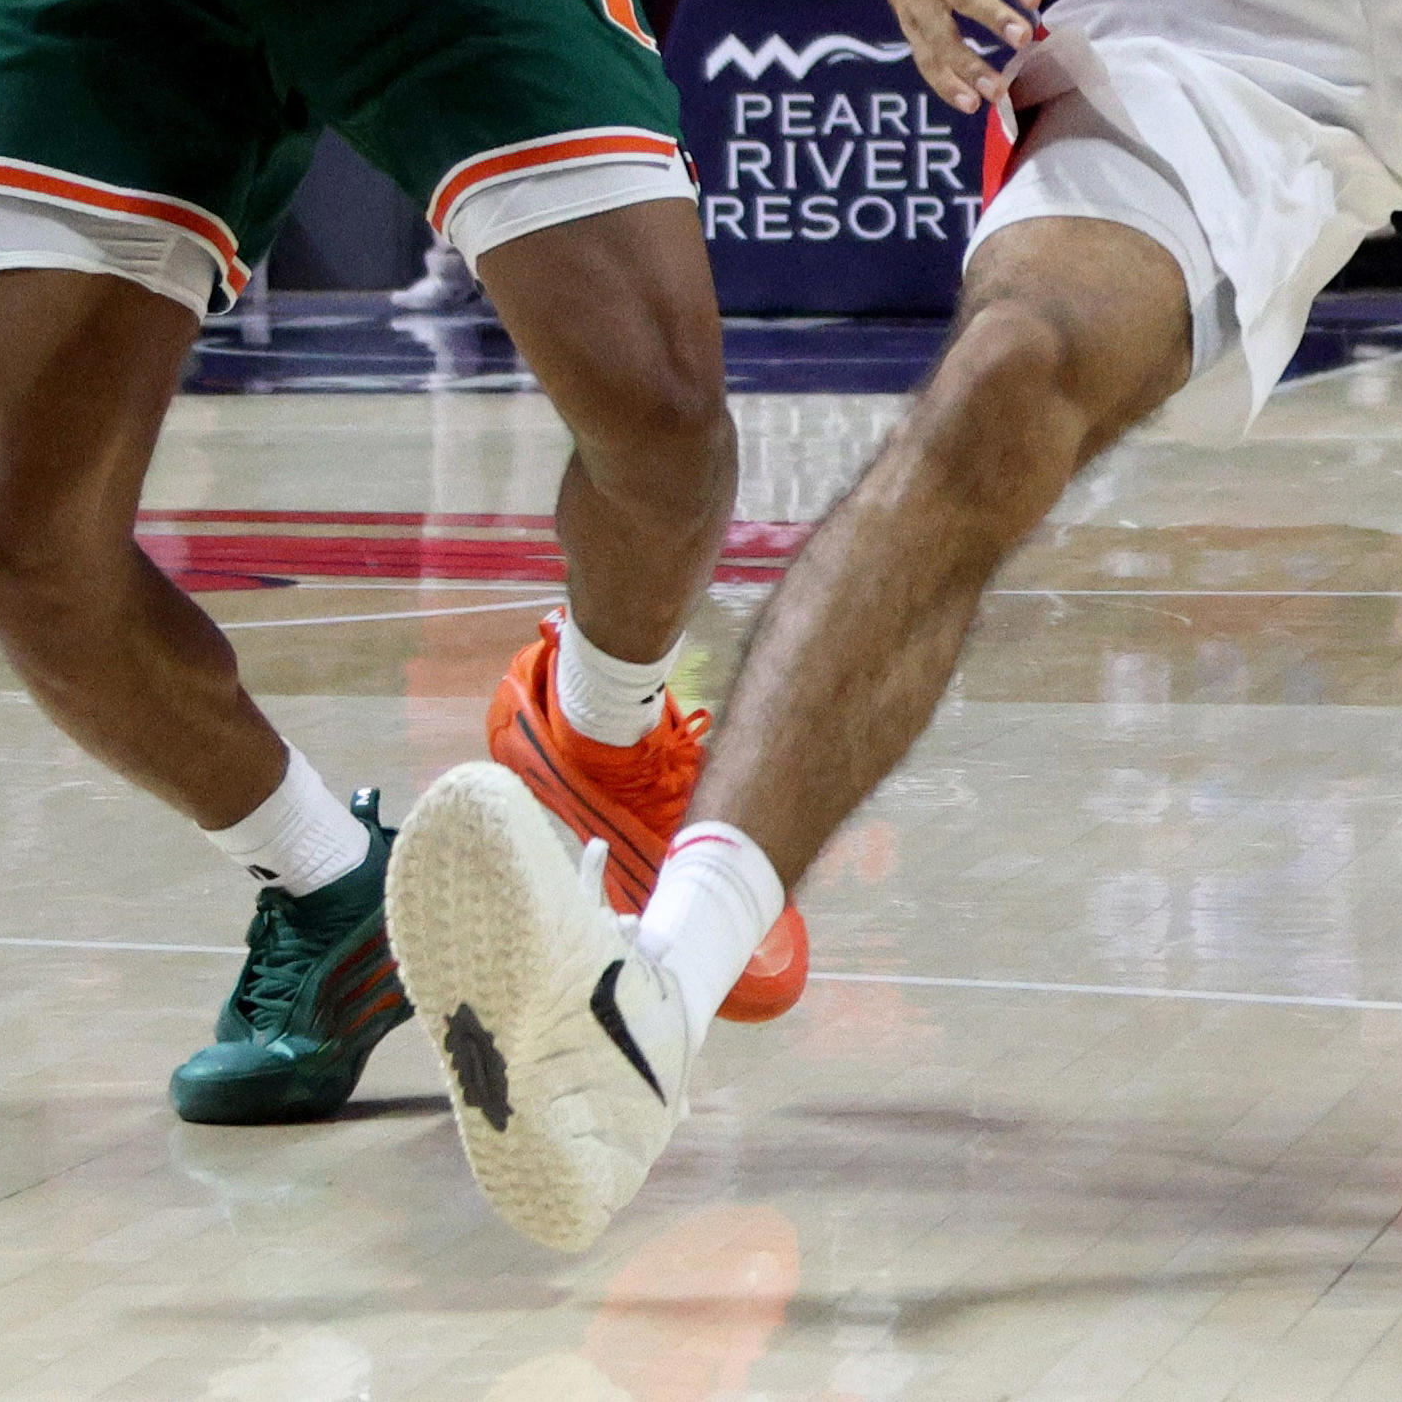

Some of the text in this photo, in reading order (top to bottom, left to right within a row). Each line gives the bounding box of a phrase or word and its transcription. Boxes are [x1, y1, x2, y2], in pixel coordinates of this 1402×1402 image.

[734, 93, 953, 136] PEARL
[726, 141, 966, 190] RIVER
[704, 195, 984, 241] RESORT
